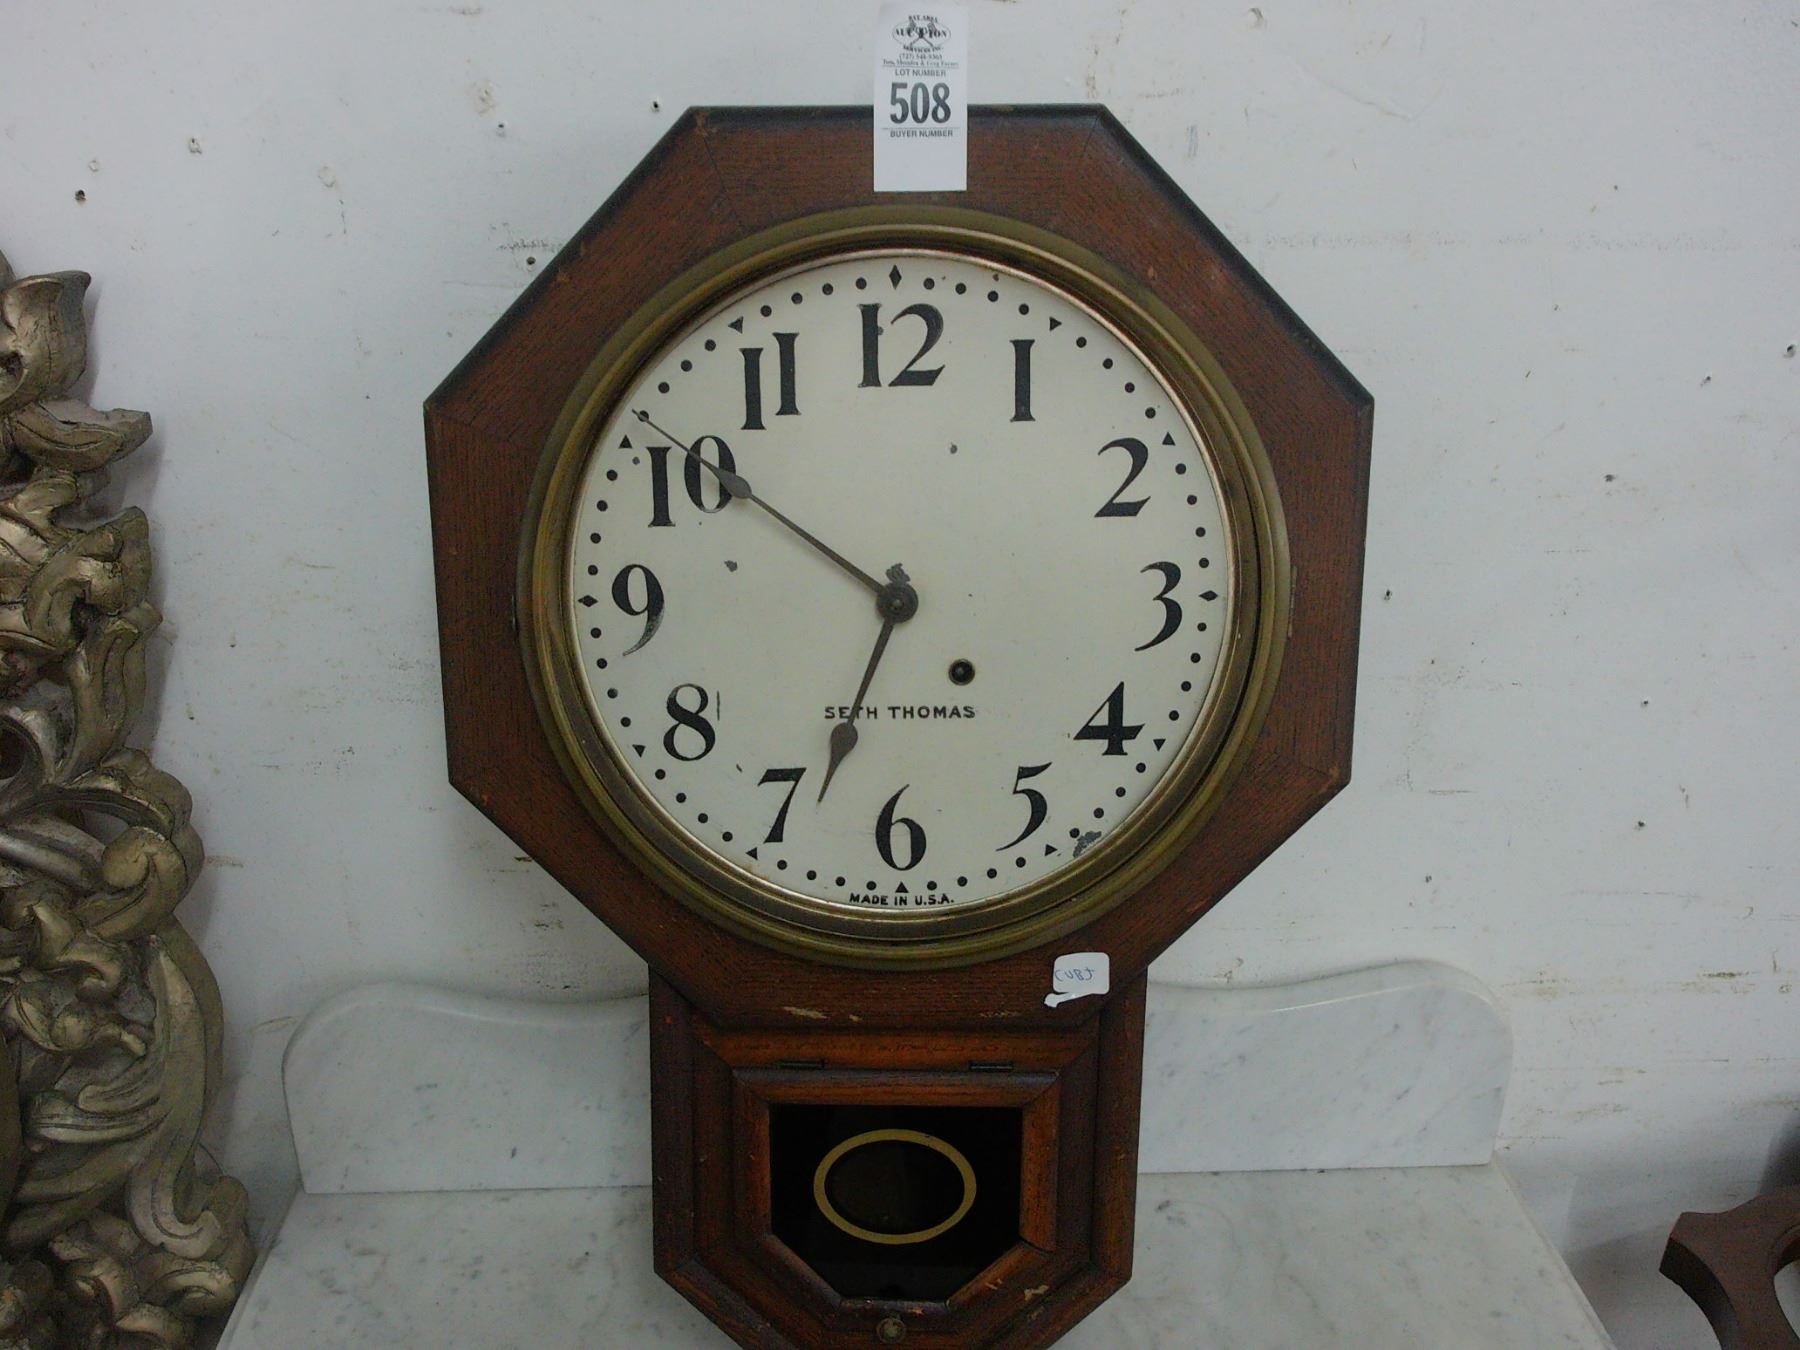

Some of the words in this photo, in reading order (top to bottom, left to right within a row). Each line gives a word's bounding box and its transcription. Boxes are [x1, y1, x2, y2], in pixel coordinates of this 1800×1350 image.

[895, 27, 948, 38] AUCTION
[890, 82, 951, 124] 508
[895, 69, 911, 77] LOT
[912, 69, 947, 78] NUMBER
[890, 129, 918, 138] BUYER
[919, 129, 954, 138] NUMBER
[741, 333, 799, 430] 11
[861, 304, 944, 387] 12
[1011, 340, 1035, 421] 1
[647, 436, 736, 527] 10
[1095, 438, 1150, 518] 2
[611, 565, 664, 656] 9
[1132, 561, 1182, 652] 3
[663, 683, 716, 762] 8
[824, 706, 878, 720] SETH
[888, 706, 976, 719] THOMAS
[1073, 682, 1145, 756] 4
[757, 767, 807, 846] 7
[875, 784, 926, 871] 6
[995, 761, 1053, 852] 5
[849, 892, 889, 906] MADE
[894, 895, 908, 906] IN
[915, 893, 955, 906] U.S.A.
